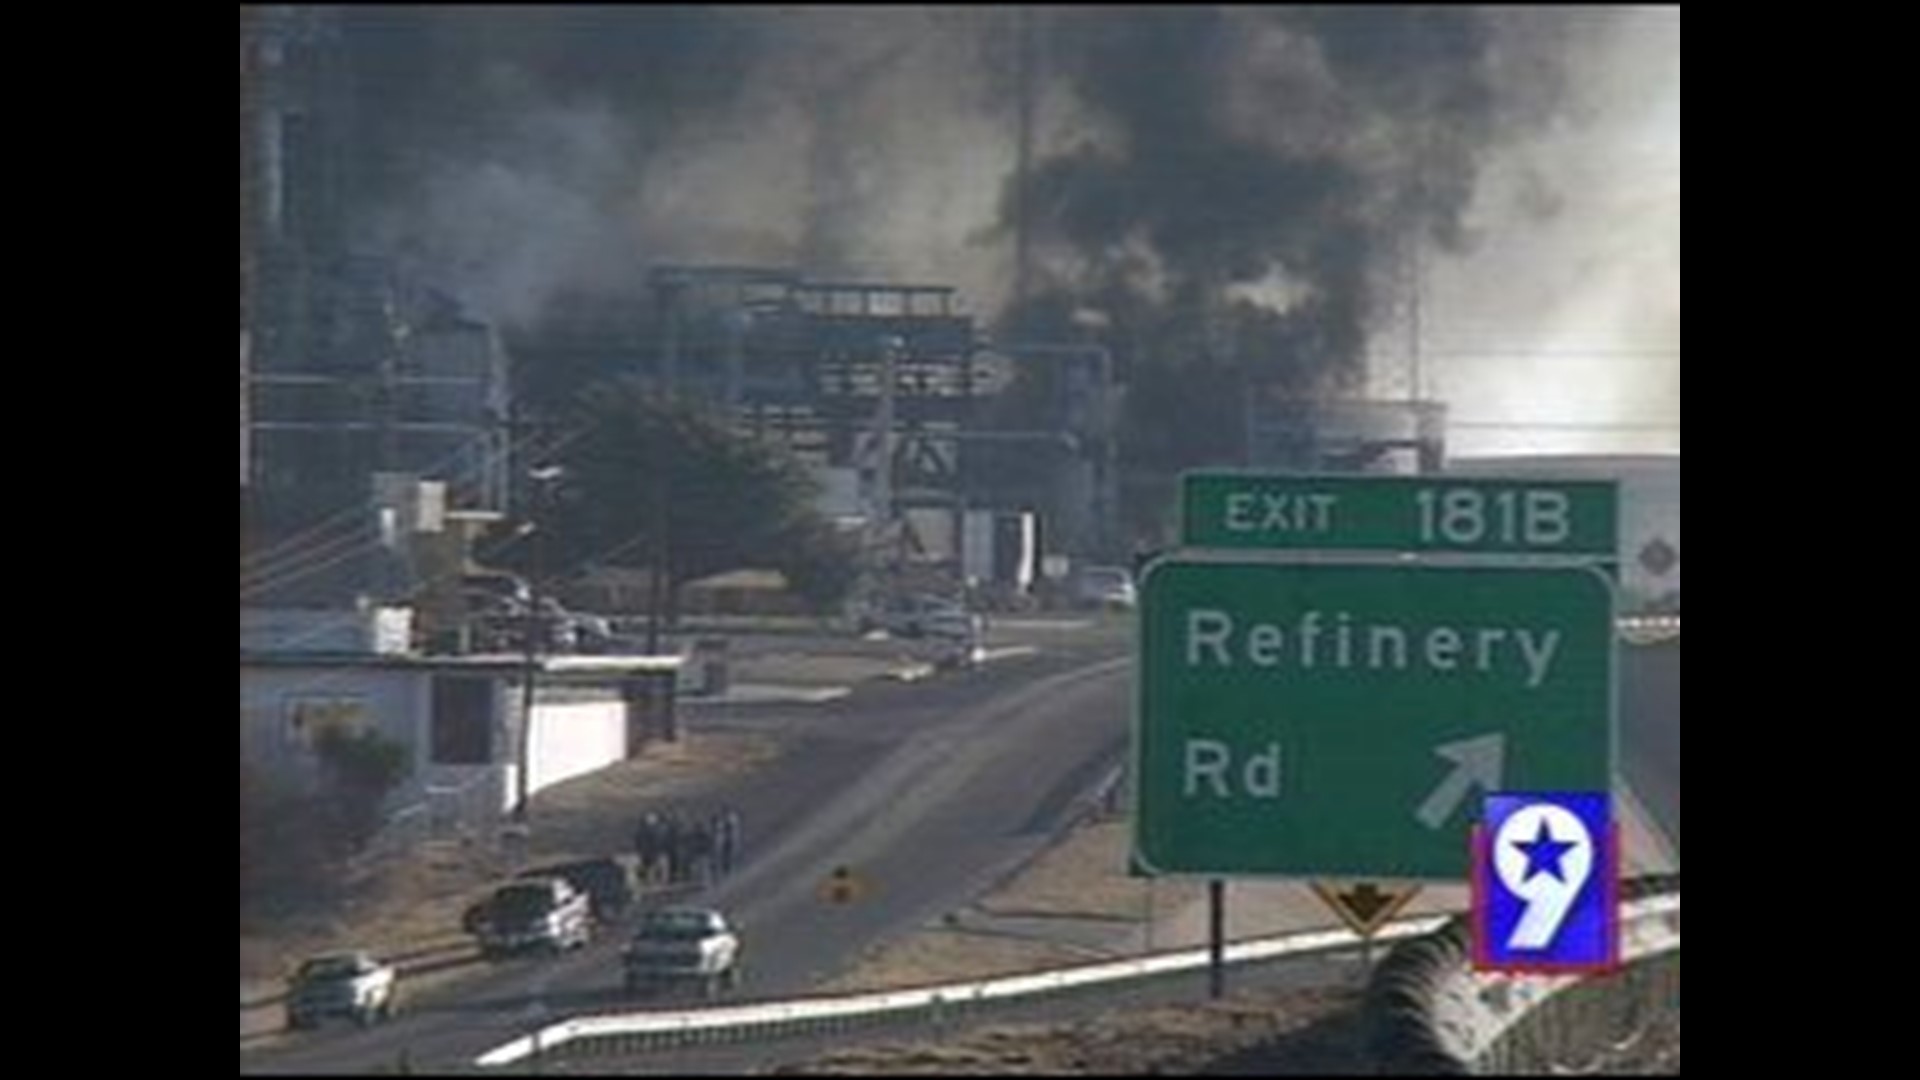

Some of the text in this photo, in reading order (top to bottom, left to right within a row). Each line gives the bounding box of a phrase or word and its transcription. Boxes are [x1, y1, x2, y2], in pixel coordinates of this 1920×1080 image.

[1225, 488, 1571, 544] EXIT 181B
[1186, 610, 1561, 686] Refinery
[1184, 739, 1281, 797] Rd
